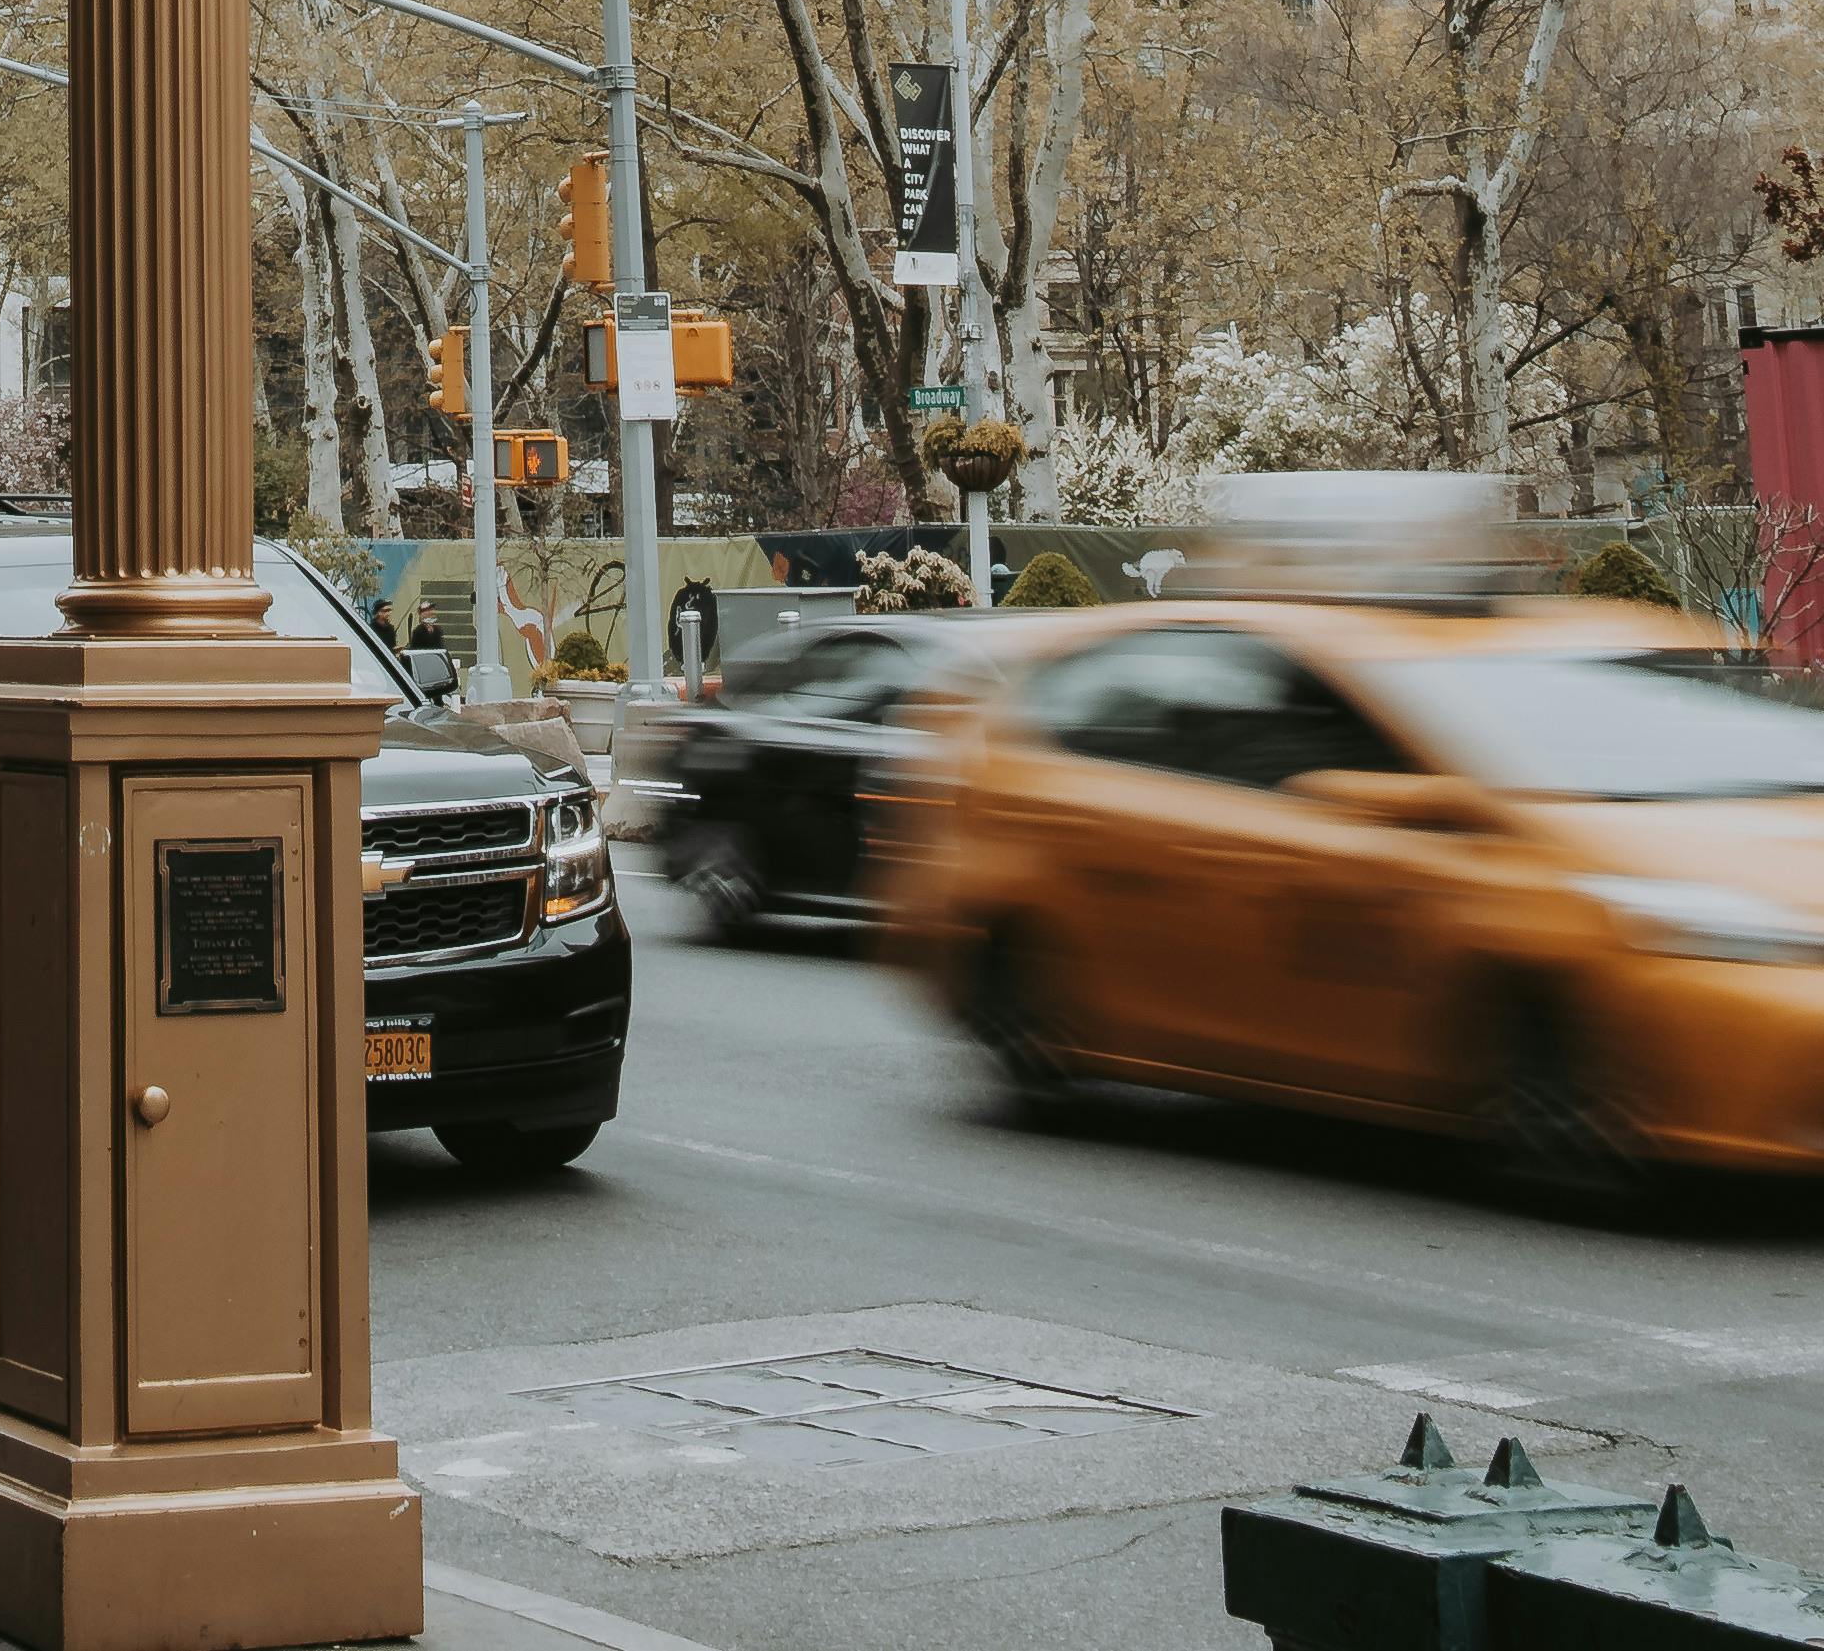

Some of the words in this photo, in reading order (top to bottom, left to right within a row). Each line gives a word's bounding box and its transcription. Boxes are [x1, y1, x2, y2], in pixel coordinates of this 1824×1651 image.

[899, 127, 951, 141] DISCOVER
[901, 143, 930, 155] WHAT
[904, 158, 911, 169] A
[905, 173, 924, 185] CITY
[904, 188, 928, 200] PARK
[903, 203, 923, 215] CAN
[902, 218, 915, 230] BE
[914, 389, 961, 408] Broadway
